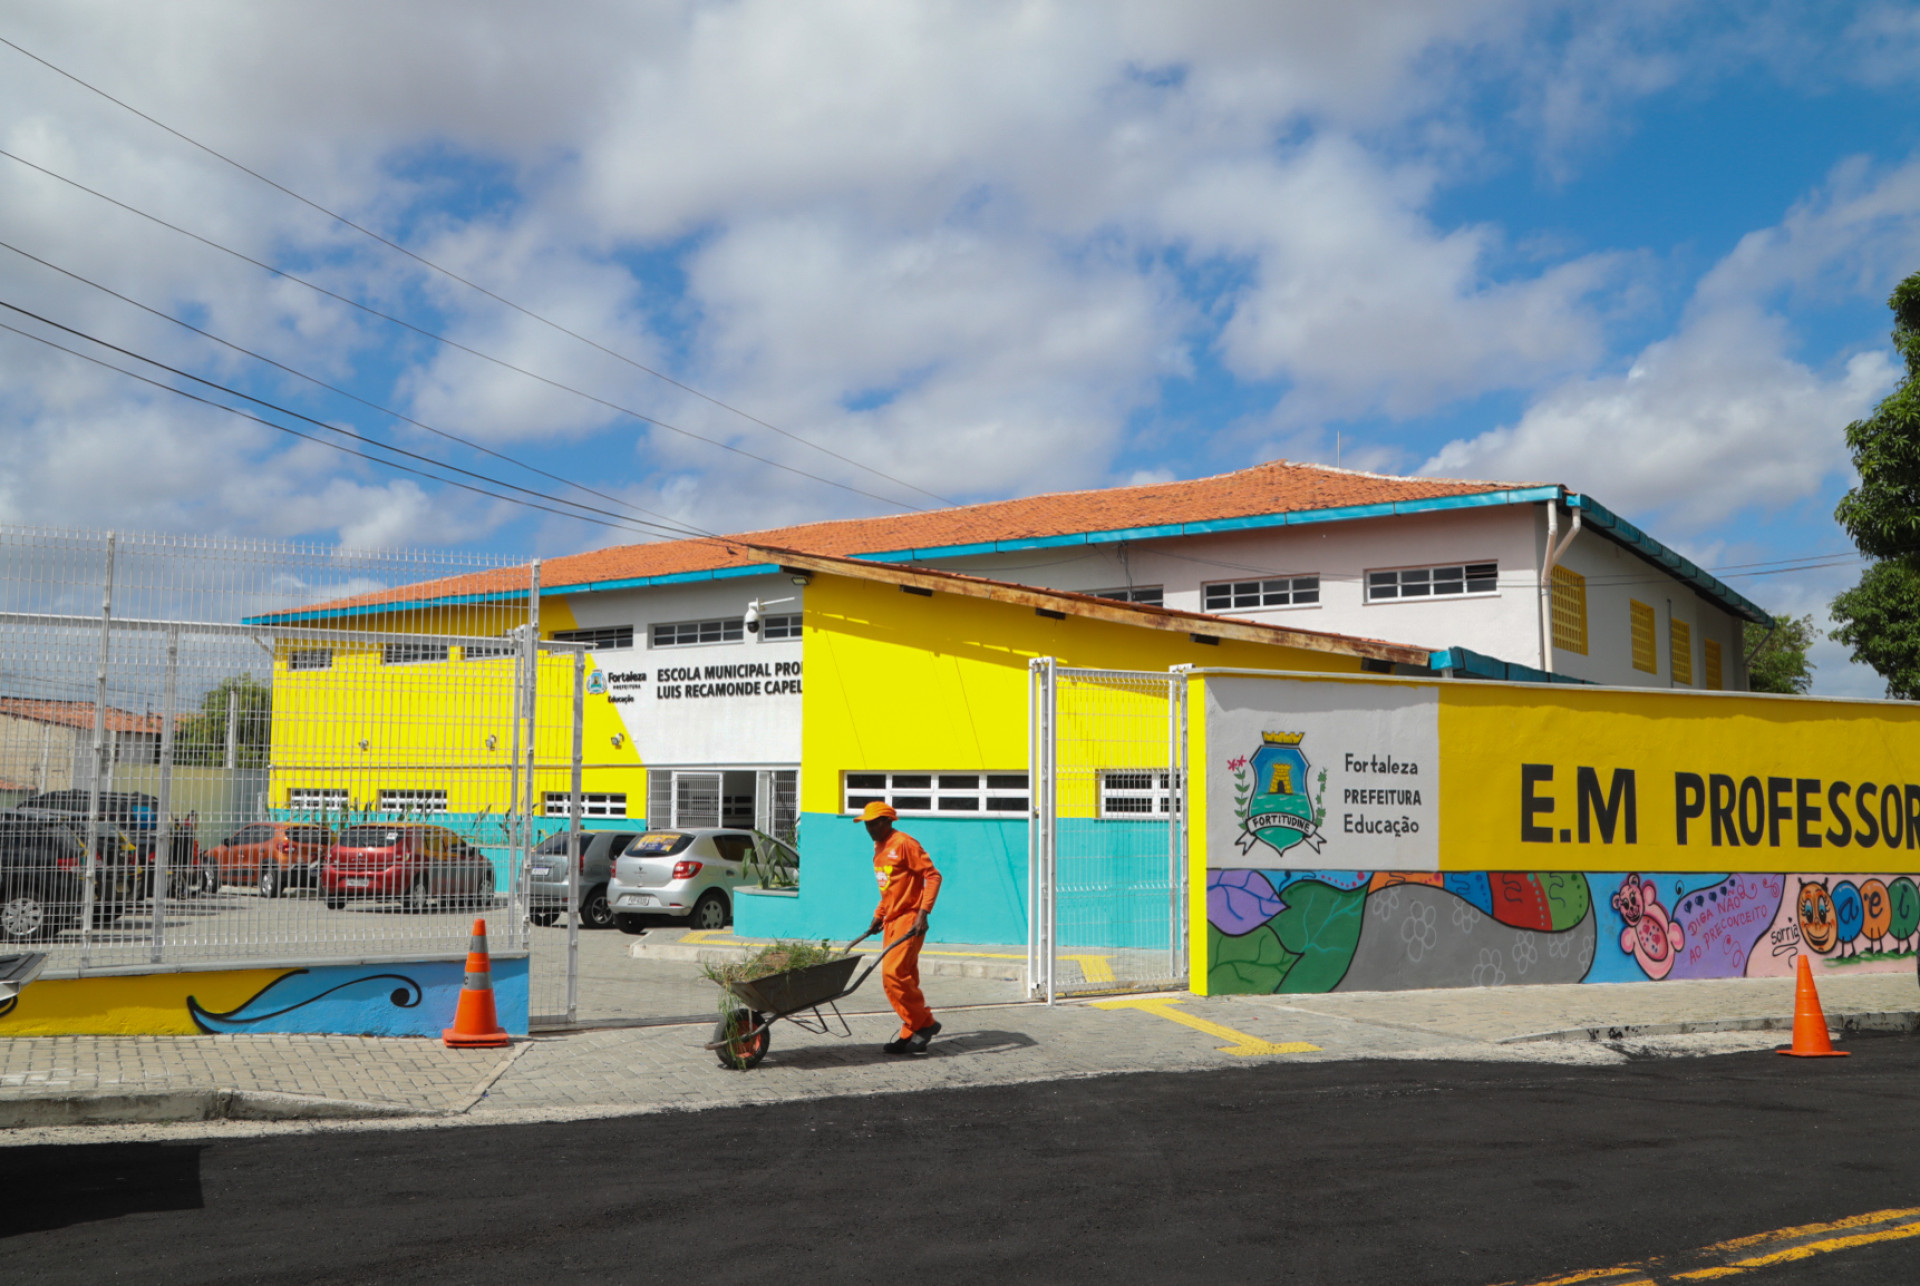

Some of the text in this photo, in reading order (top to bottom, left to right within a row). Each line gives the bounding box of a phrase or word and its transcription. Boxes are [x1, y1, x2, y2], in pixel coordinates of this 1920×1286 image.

[608, 671, 647, 683] Fortaleza
[657, 667, 701, 682] ESCOLA
[704, 663, 771, 680] MUNICIPAL
[657, 684, 681, 699] LUIS
[685, 681, 761, 698] RECAMONDE
[1345, 752, 1418, 775] Fortaleza
[1344, 788, 1422, 806] PREFEITURA
[1521, 763, 1920, 850] E.M PROFESSOR
[1252, 814, 1311, 833] FORTITUDINE
[1344, 813, 1420, 838] Educação
[1687, 889, 1742, 937] DIGA NÃO
[1689, 904, 1769, 965] AO PRECONCEITO
